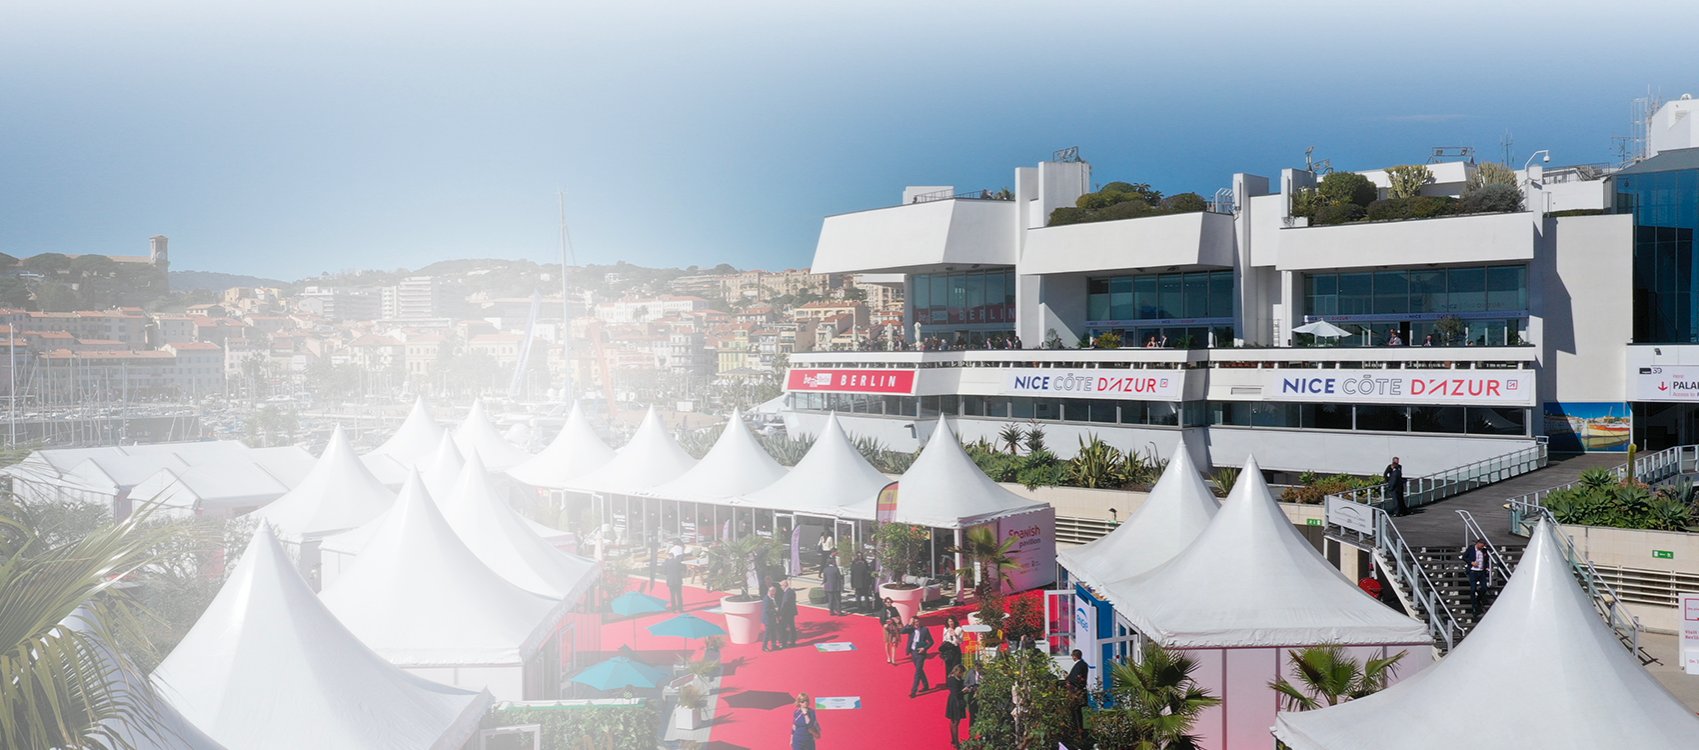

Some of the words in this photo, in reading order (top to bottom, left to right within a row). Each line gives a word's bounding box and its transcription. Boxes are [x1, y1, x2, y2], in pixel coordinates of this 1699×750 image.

[840, 374, 897, 388] BERLIN
[1014, 376, 1050, 390] NICE
[1282, 377, 1335, 394] NICE
[1008, 525, 1041, 539] Spanish
